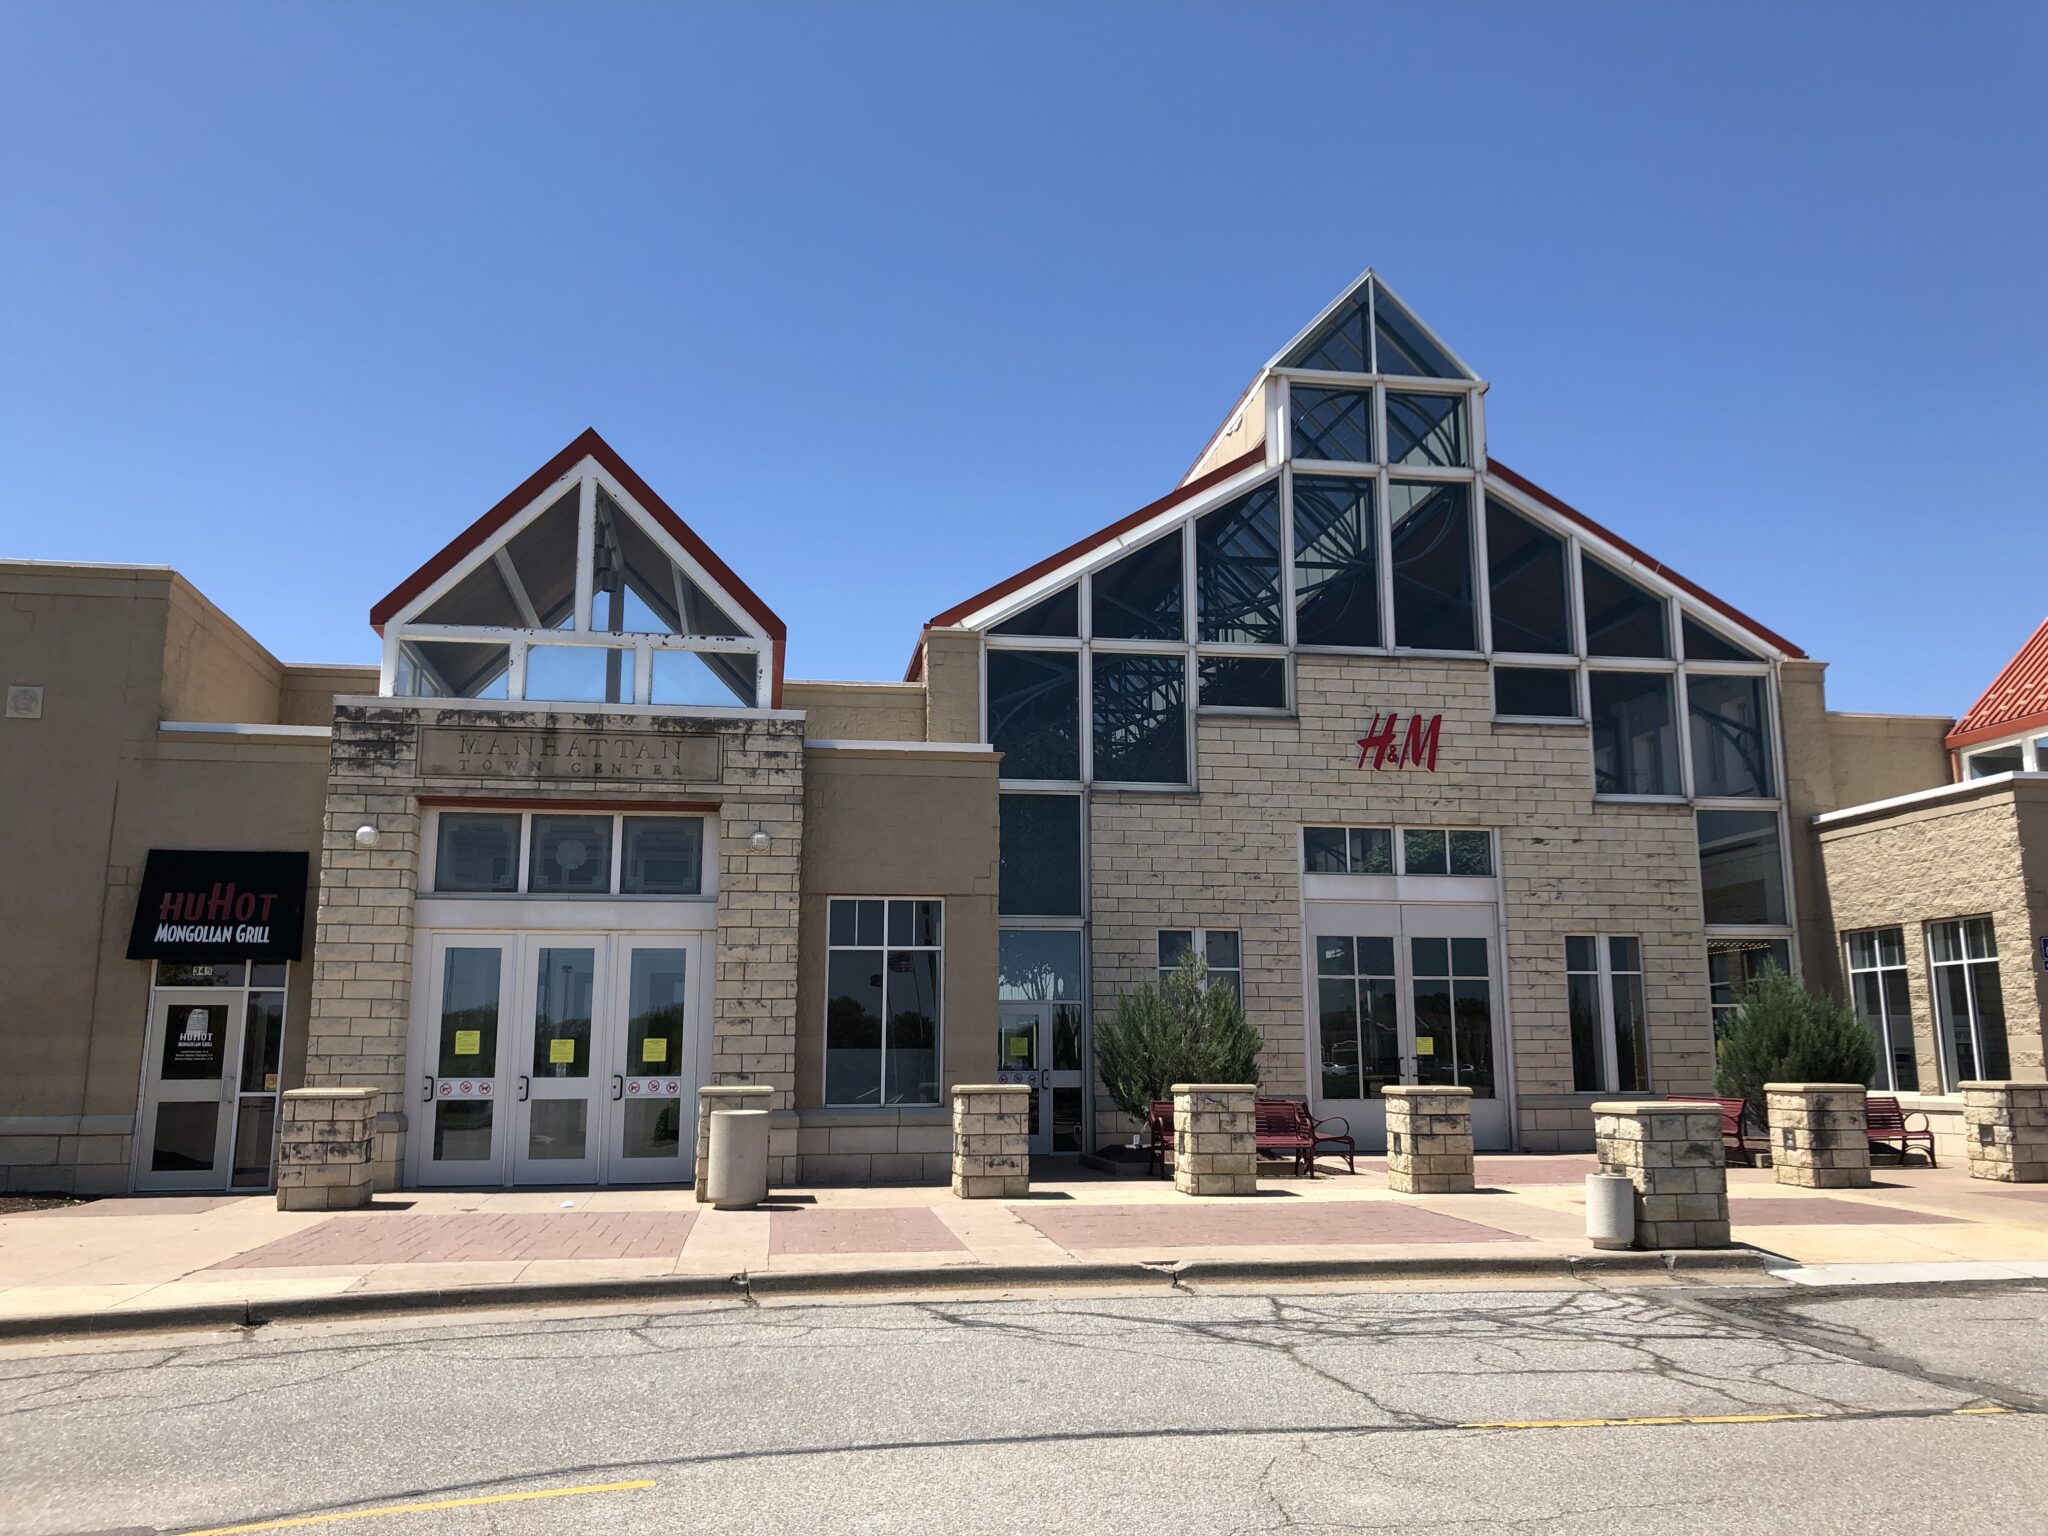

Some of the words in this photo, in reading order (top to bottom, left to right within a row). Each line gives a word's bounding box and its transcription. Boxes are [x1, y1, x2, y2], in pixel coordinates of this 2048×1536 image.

[459, 735, 683, 760] MANHATTAN
[1355, 713, 1442, 773] H&M
[459, 760, 542, 772] TOWN
[571, 762, 682, 775] CENTER
[154, 923, 233, 943] MONGOLIAN
[236, 924, 269, 943] GRILL
